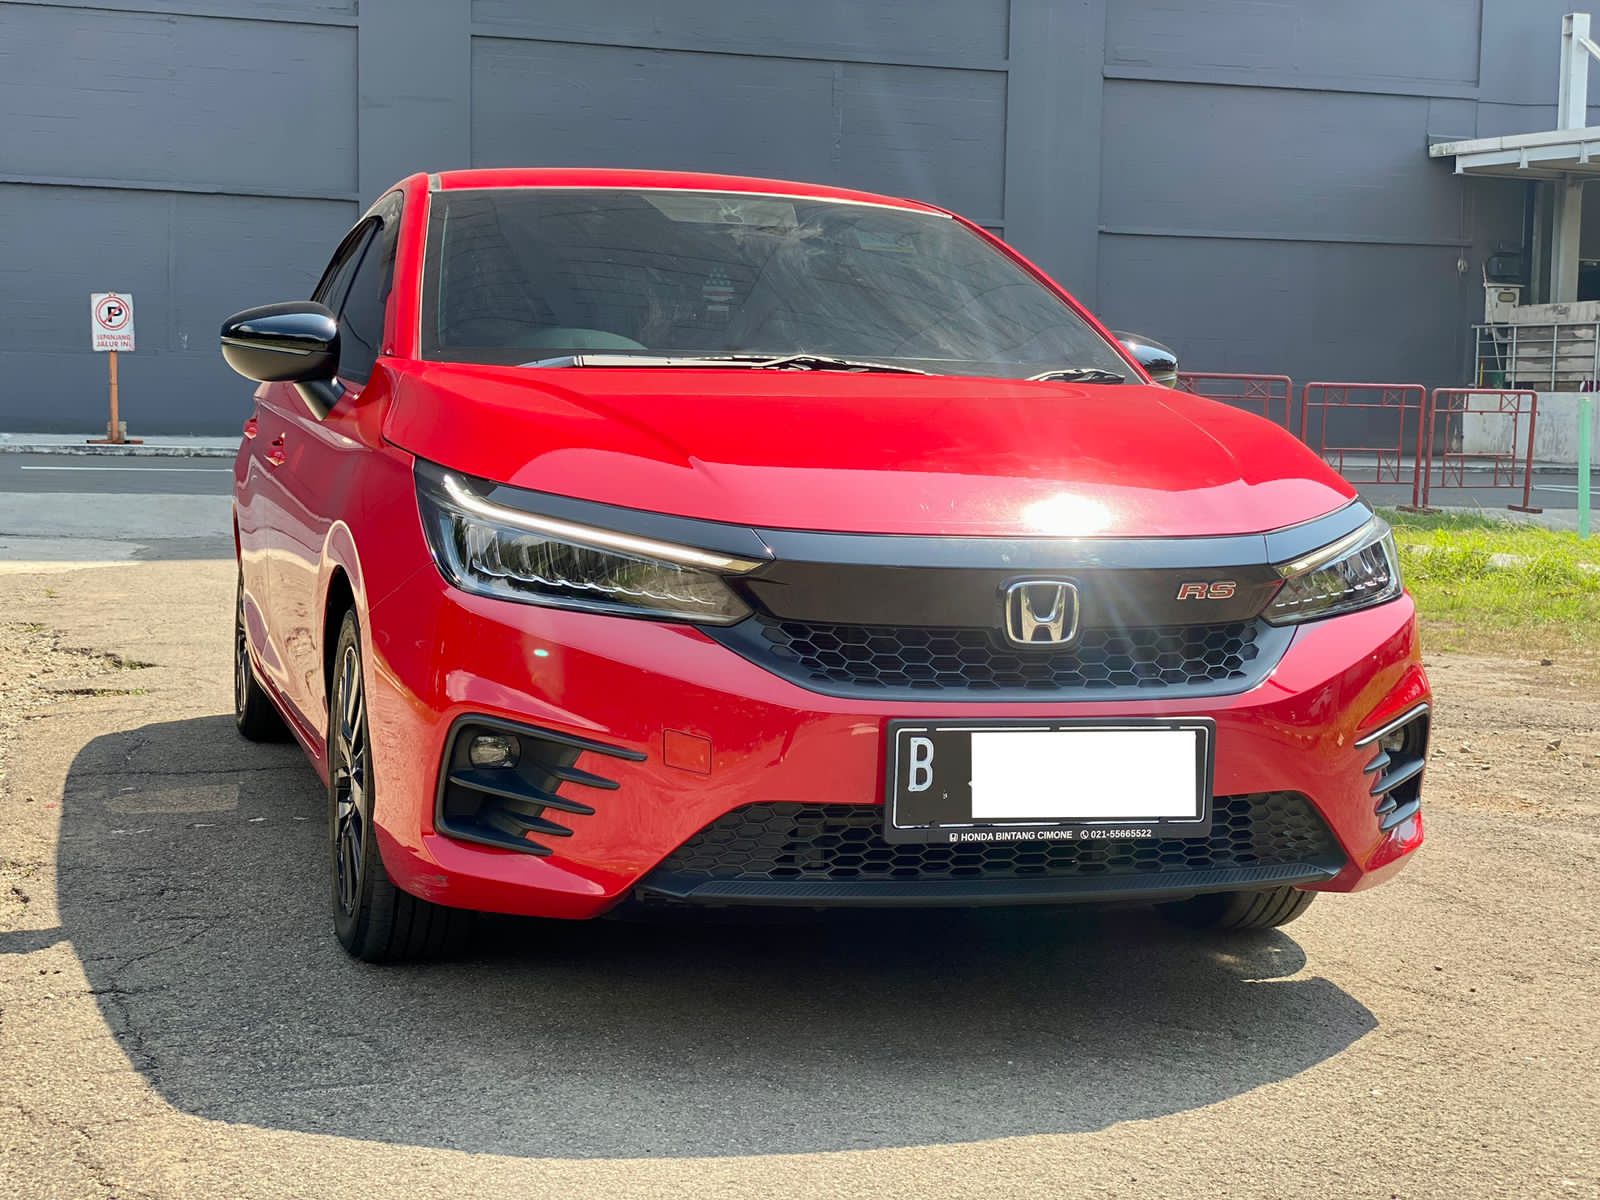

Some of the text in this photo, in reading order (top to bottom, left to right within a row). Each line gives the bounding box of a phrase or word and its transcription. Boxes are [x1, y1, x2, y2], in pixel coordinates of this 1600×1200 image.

[1176, 581, 1237, 600] RS
[907, 736, 934, 792] B
[961, 829, 1152, 841] HONDA BINTANG CIMONE 021-55665522
